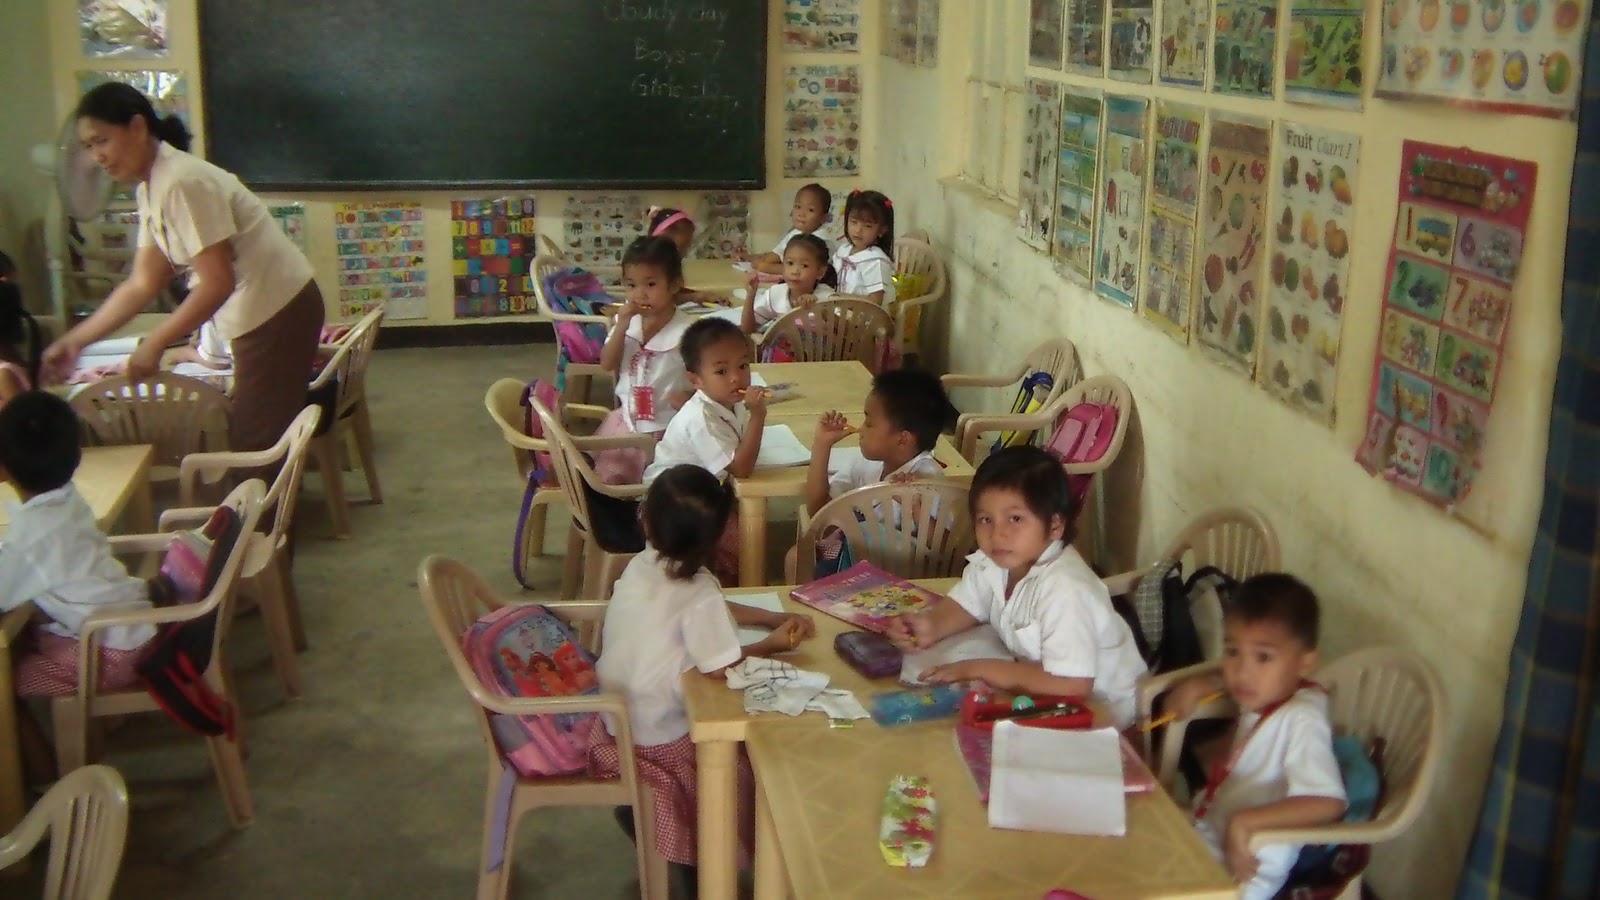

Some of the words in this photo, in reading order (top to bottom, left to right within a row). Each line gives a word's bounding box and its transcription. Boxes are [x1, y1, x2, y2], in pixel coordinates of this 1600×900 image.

[635, 37, 685, 69] Boys
[1285, 129, 1313, 151] Fruit
[1460, 222, 1476, 258] 6
[1452, 277, 1470, 313] 7
